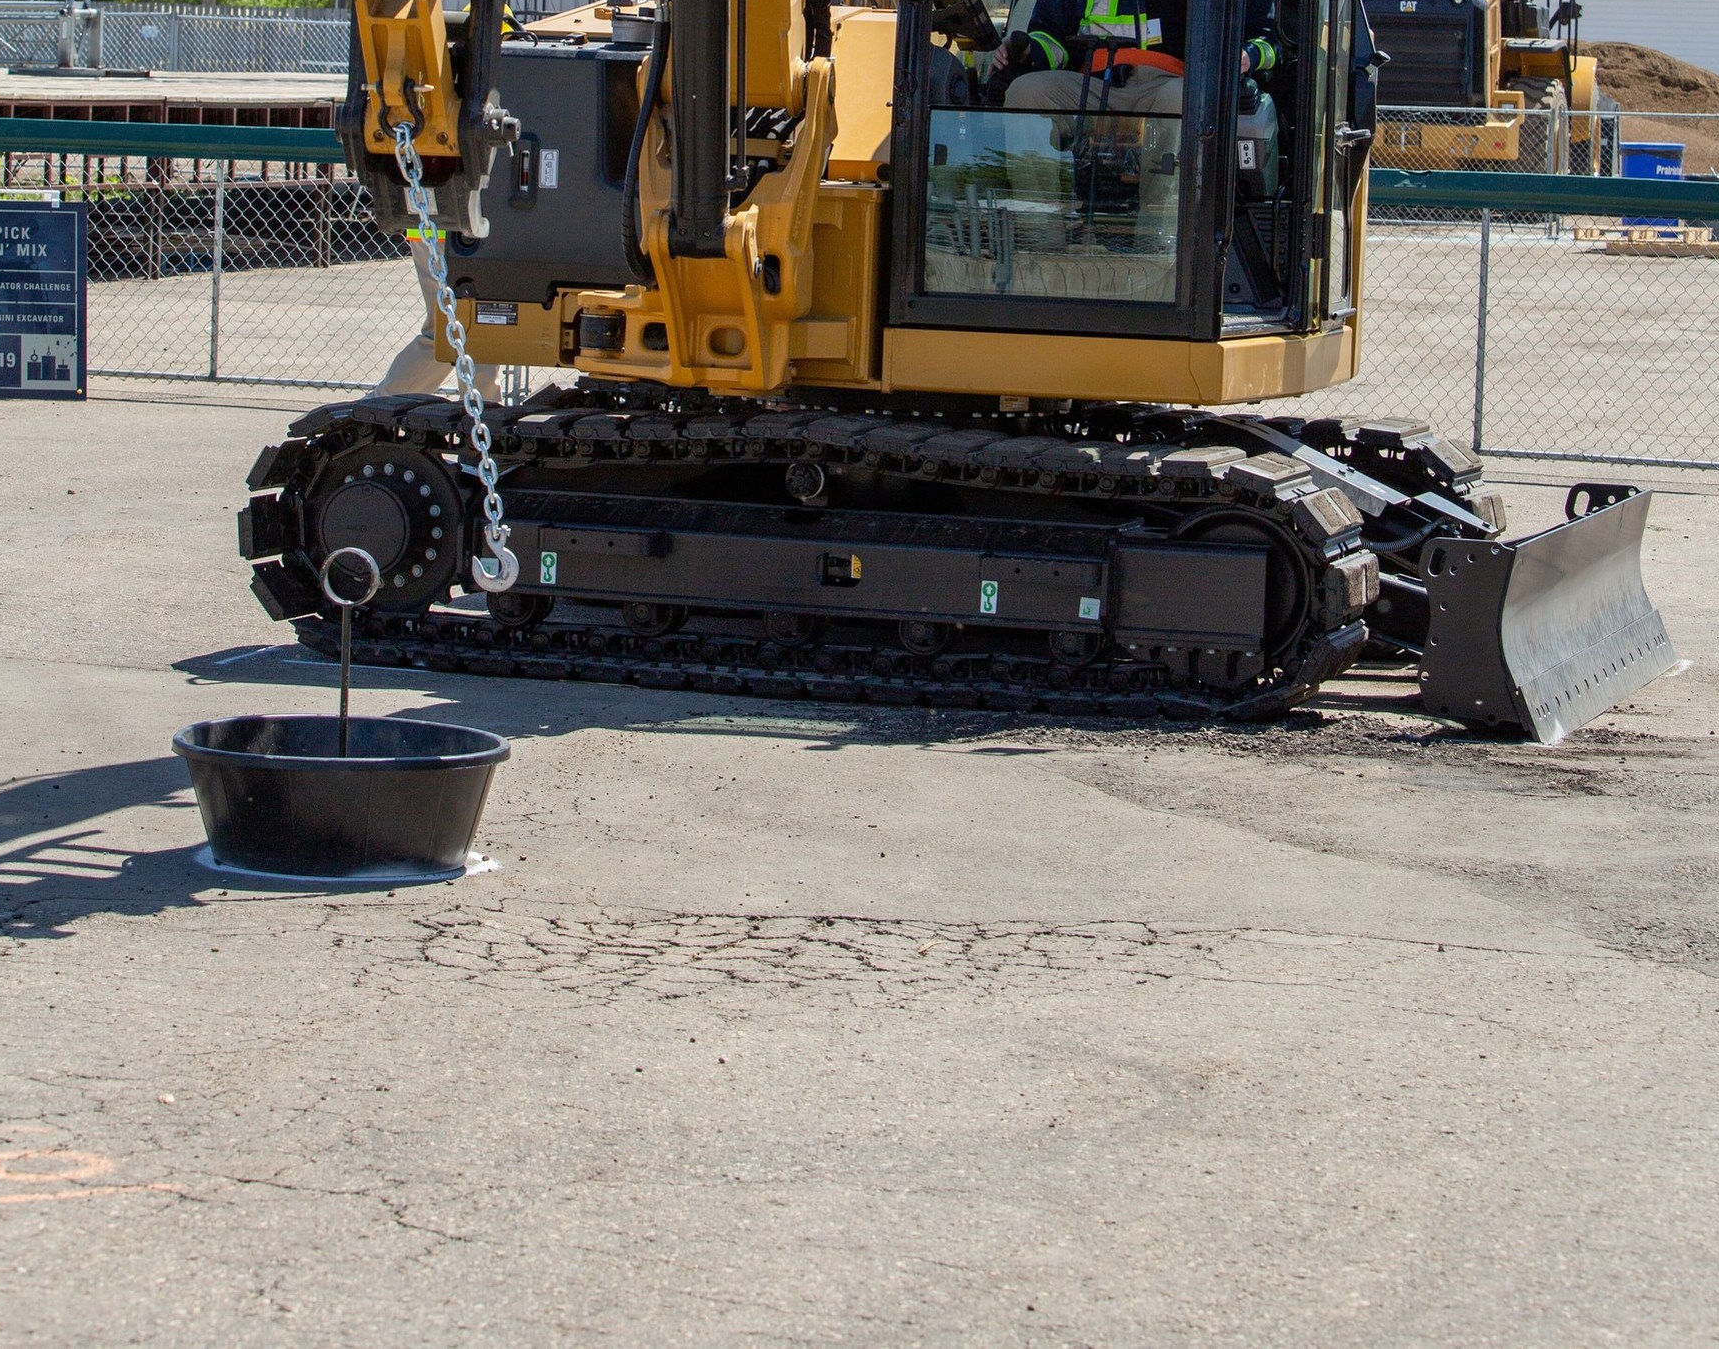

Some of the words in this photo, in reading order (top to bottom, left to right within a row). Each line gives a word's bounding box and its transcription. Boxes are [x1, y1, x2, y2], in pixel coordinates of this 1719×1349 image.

[1399, 0, 1418, 12] CAT
[17, 244, 48, 258] MIX
[23, 282, 71, 292] CHALLENGE
[16, 314, 64, 324] EXCAVATOR
